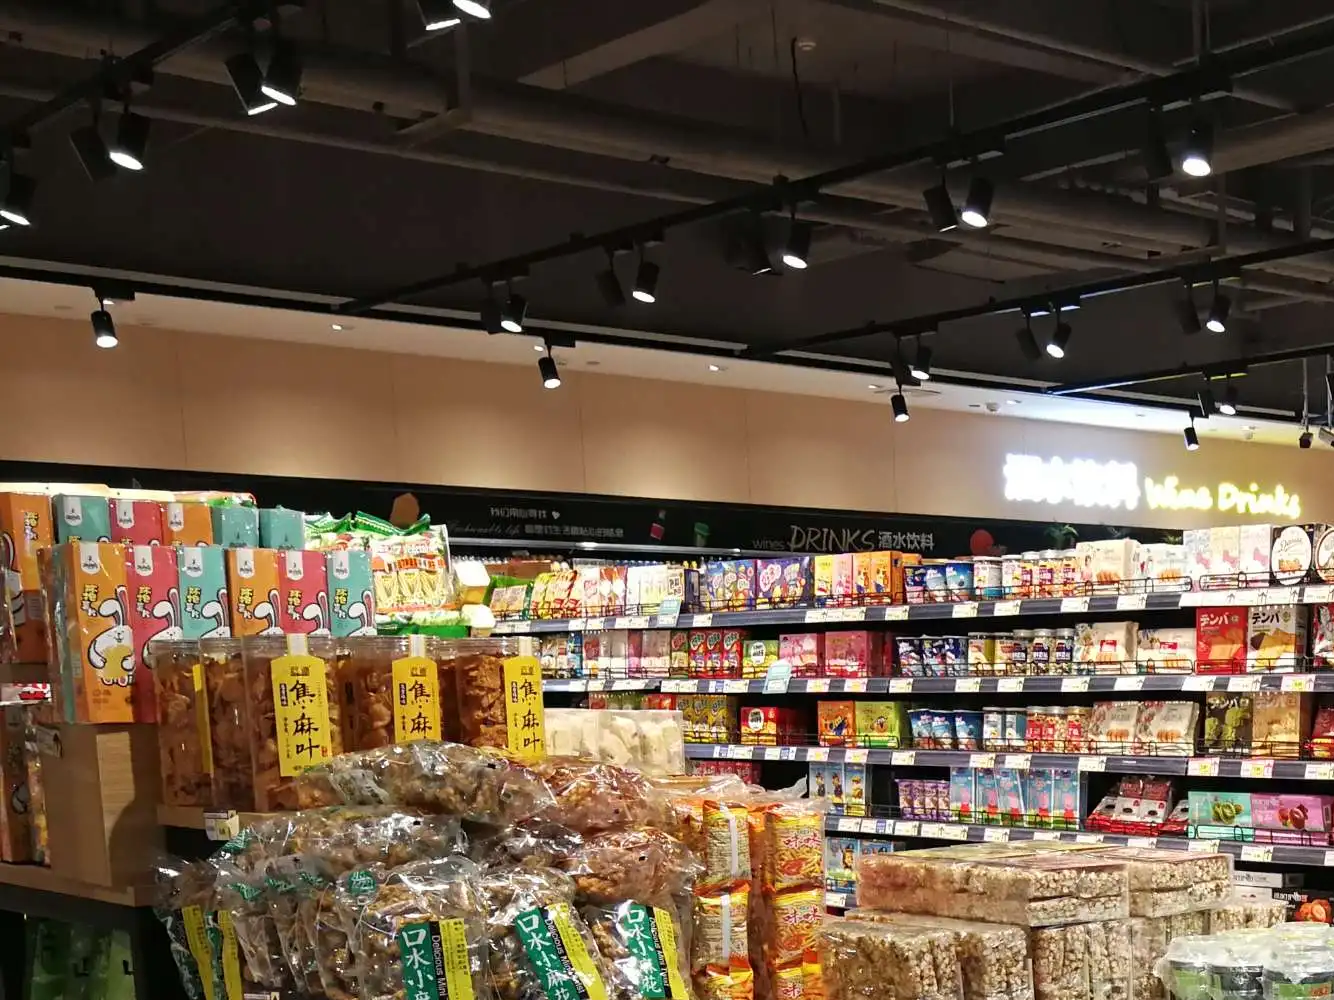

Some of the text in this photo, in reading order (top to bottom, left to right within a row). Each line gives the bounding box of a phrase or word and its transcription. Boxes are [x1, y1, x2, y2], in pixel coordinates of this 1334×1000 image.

[1145, 475, 1212, 510] Wine
[1218, 482, 1300, 519] Drinks
[787, 525, 875, 552] DRINKS
[878, 531, 935, 550] 酒水饮料
[431, 934, 445, 976] Delicious
[624, 907, 663, 994] 口水小麻花
[435, 977, 447, 997] Mini
